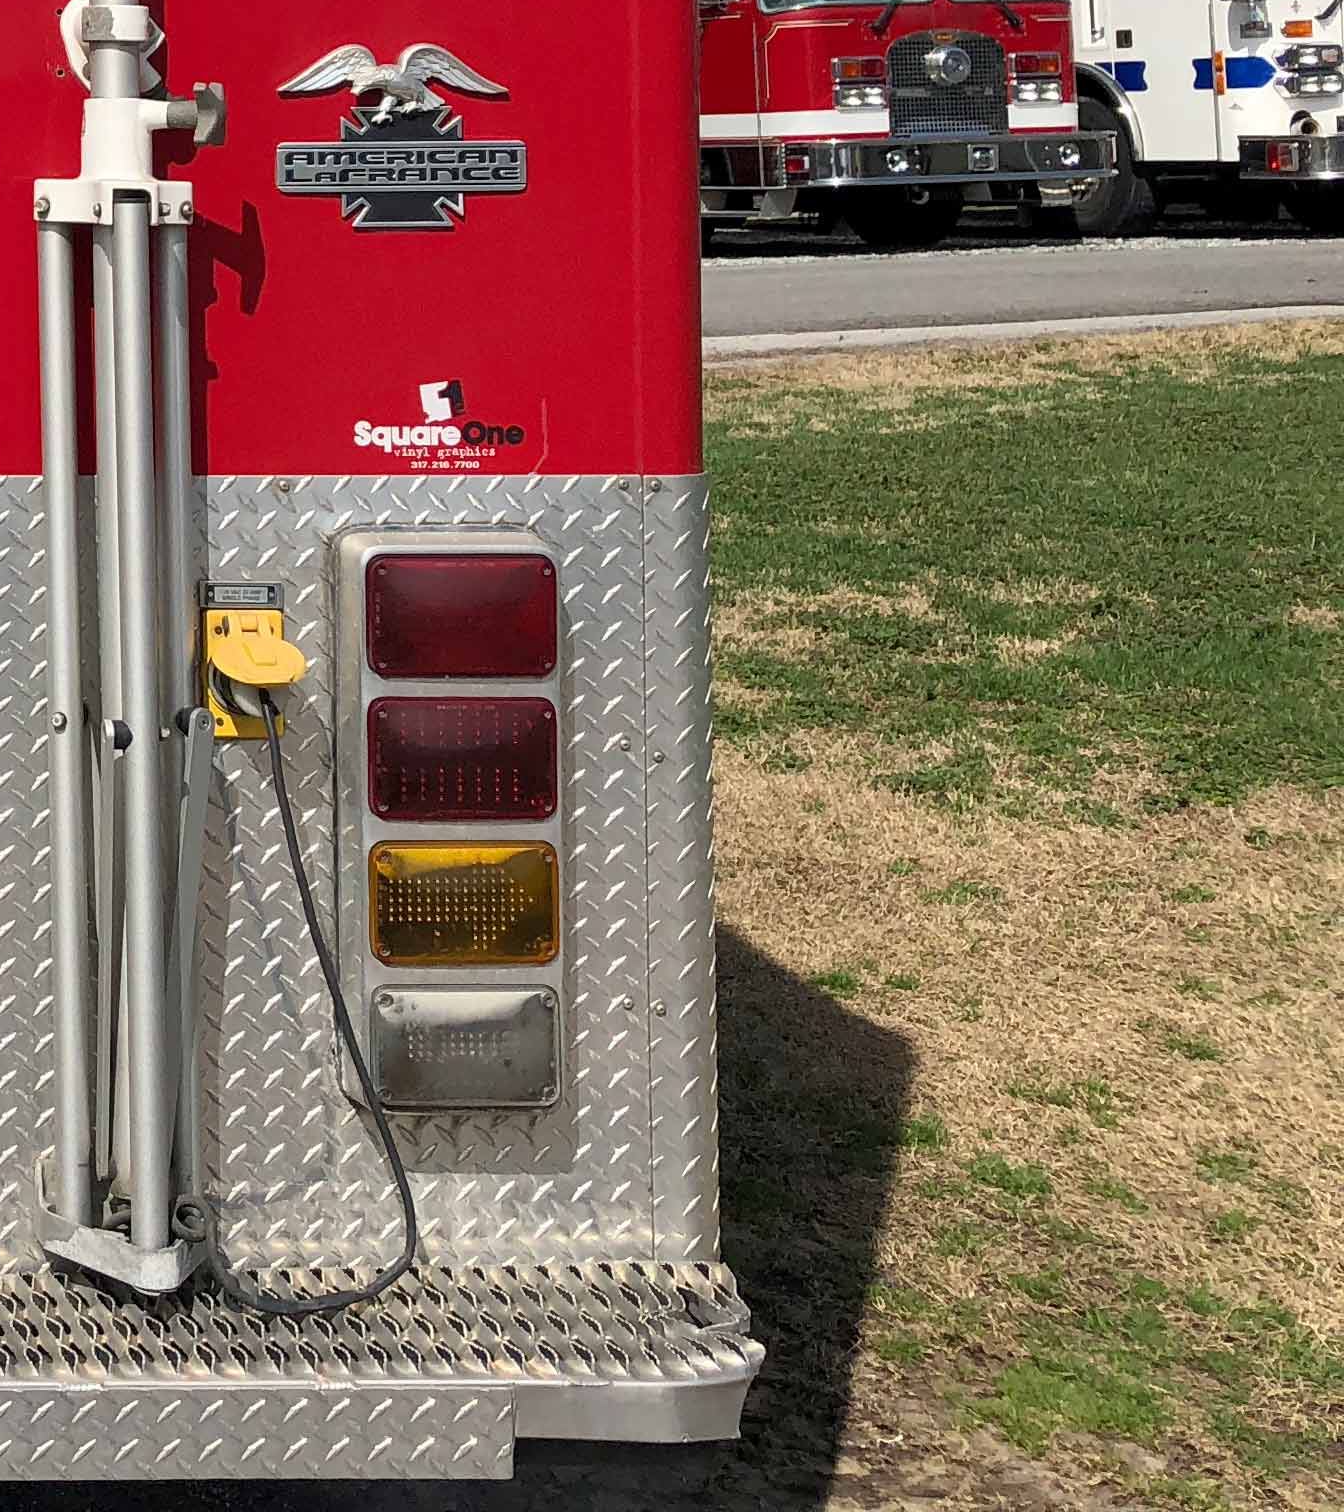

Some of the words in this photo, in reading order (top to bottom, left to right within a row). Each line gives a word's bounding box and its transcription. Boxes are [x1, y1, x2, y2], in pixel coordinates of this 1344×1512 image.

[284, 149, 520, 166] AMERICAN
[353, 420, 525, 453] SquareOne
[393, 446, 430, 459] vinyl
[436, 446, 496, 459] graphics
